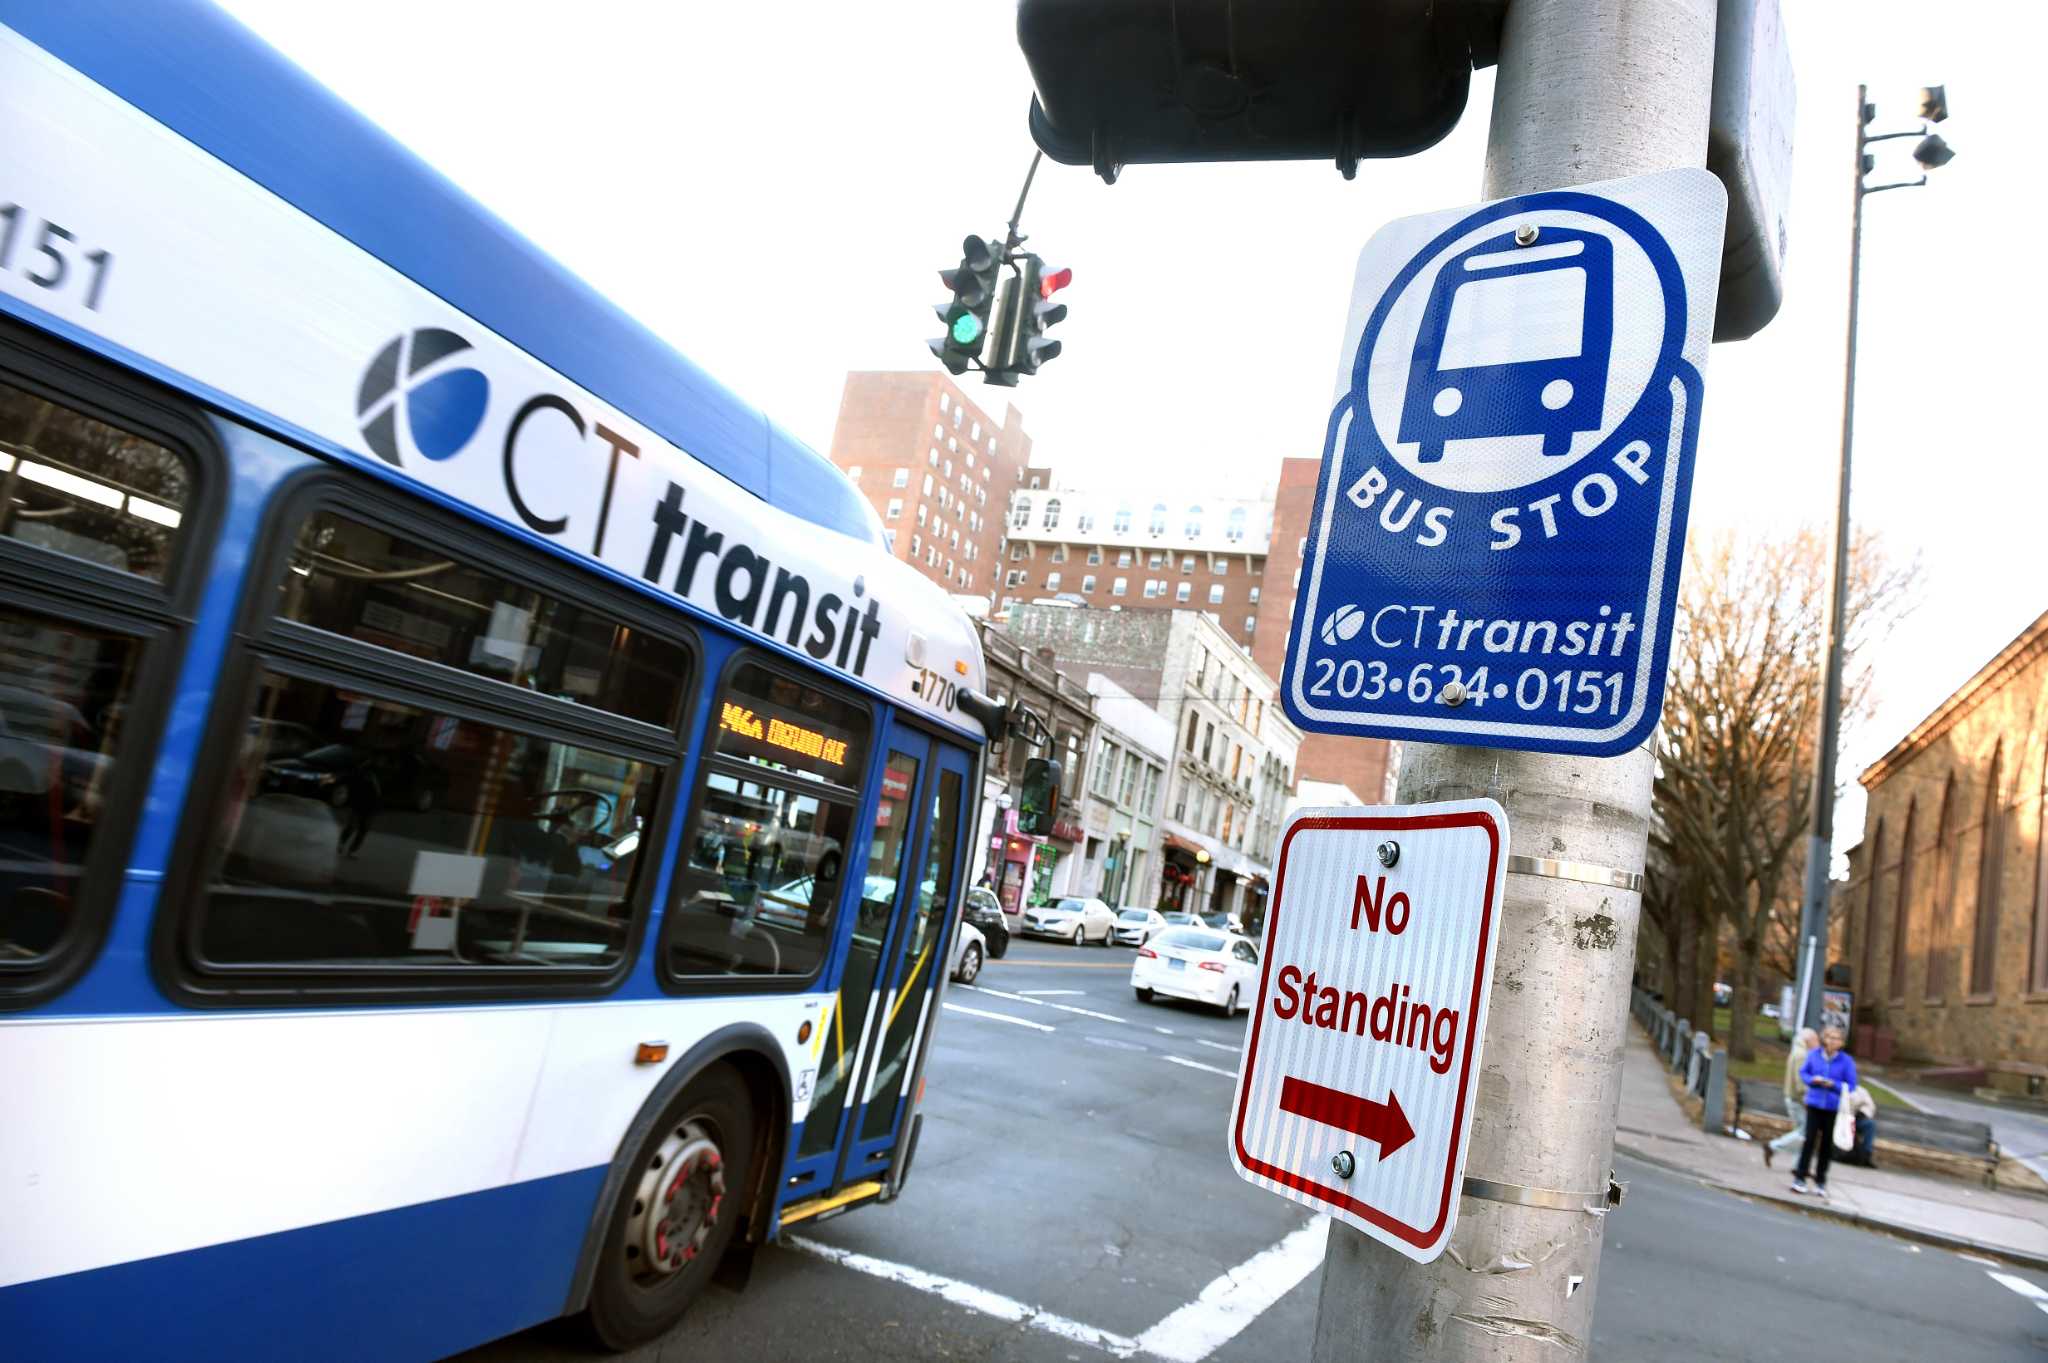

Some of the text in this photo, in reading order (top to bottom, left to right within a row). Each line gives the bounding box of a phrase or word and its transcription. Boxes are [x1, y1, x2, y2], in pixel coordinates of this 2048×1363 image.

[1346, 439, 1652, 551] BUS STOP
[919, 668, 956, 712] 1770
[1350, 874, 1411, 936] No
[1273, 964, 1460, 1075] Standing
